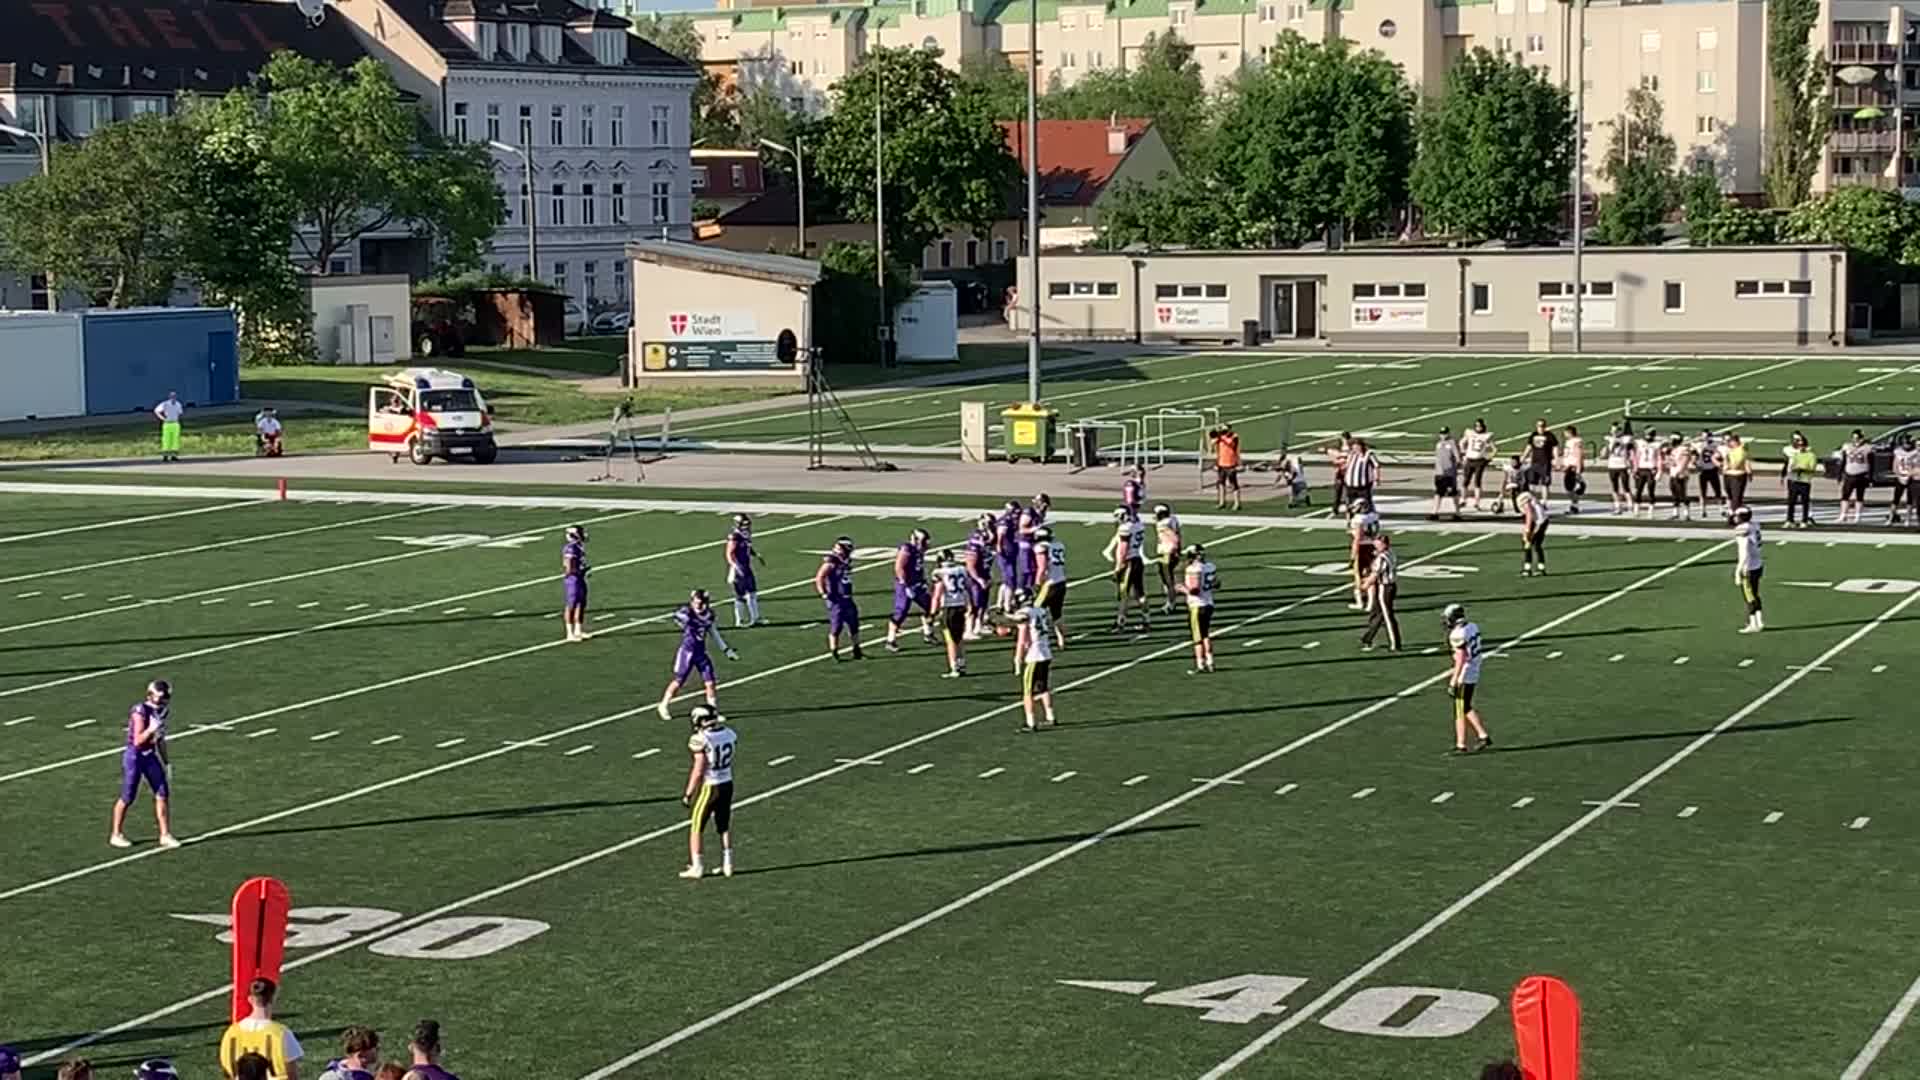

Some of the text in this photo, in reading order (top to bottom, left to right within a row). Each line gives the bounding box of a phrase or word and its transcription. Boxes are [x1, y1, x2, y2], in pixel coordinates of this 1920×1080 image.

[691, 313, 721, 326] Stadt
[691, 326, 722, 337] Wien
[711, 742, 733, 771] 12
[1142, 973, 1501, 1038] 40
